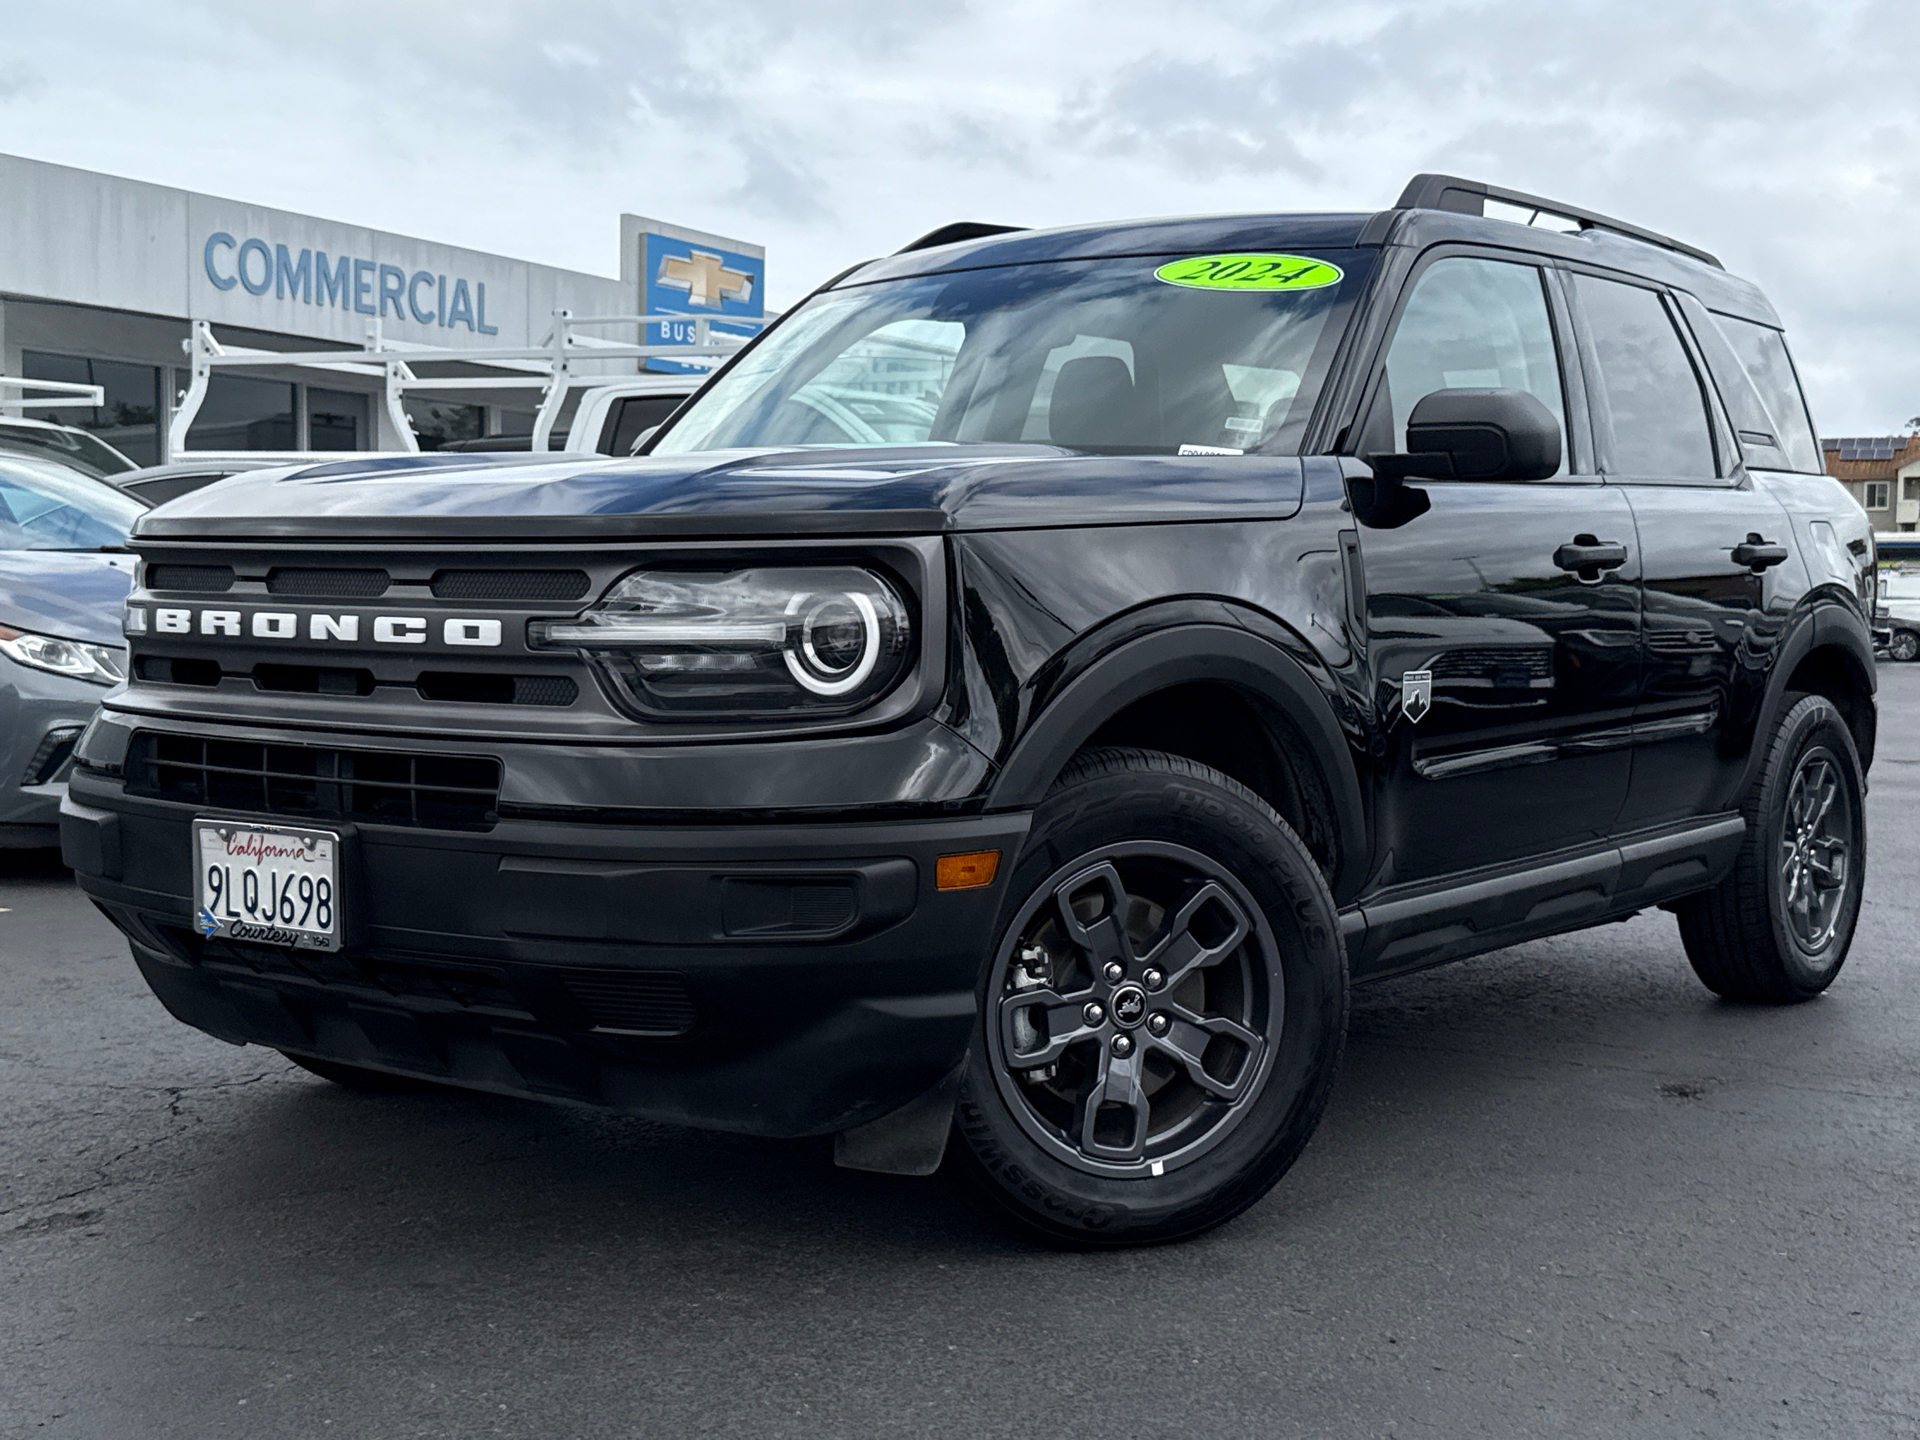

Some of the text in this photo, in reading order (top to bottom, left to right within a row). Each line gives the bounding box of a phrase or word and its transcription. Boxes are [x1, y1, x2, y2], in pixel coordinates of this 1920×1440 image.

[204, 232, 498, 335] COMMERCIAL
[1174, 261, 1321, 284] 2024
[156, 609, 502, 647] BRONCO
[227, 832, 315, 866] California
[208, 864, 332, 929] 9LQJ698
[1266, 853, 1328, 951] PLUS
[230, 919, 300, 947] Courtesy
